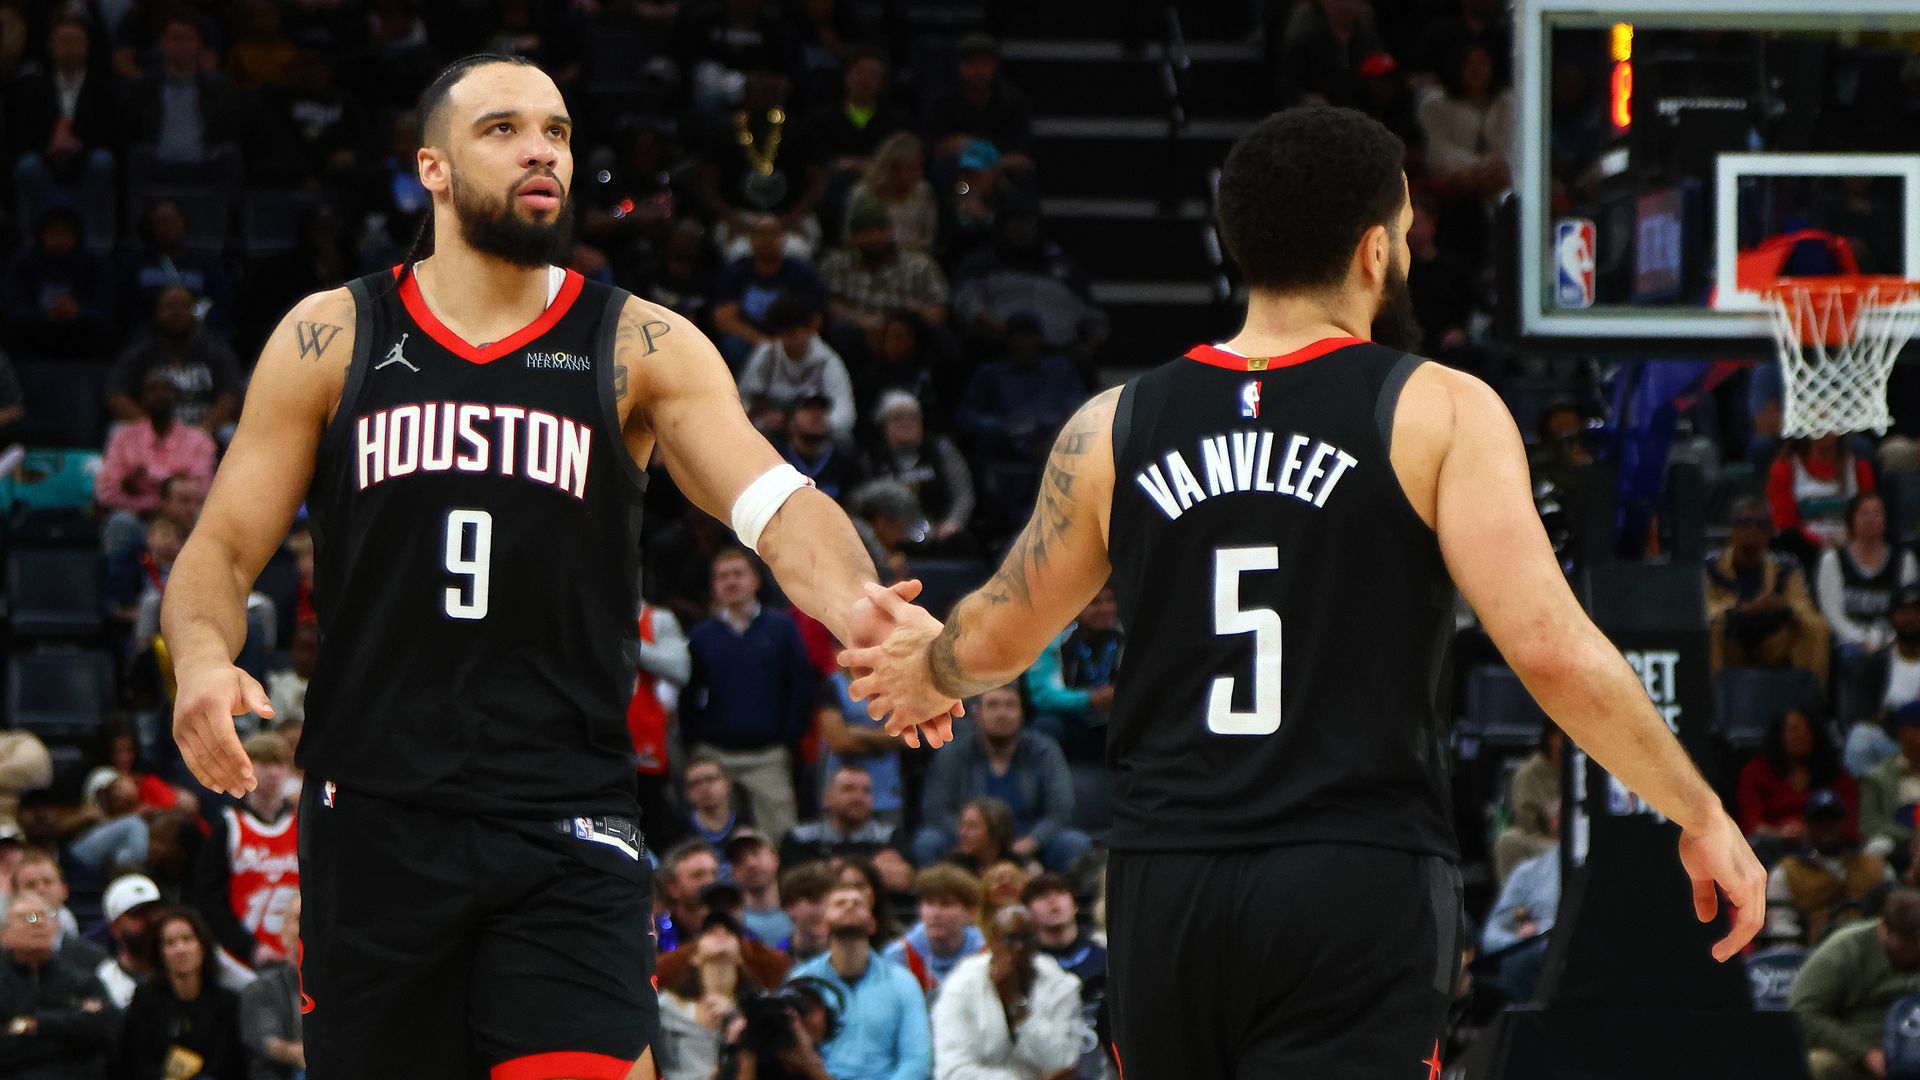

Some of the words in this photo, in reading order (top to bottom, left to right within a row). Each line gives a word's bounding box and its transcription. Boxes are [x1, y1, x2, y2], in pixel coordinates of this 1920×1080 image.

[296, 320, 343, 362] W
[526, 359, 590, 371] HERMANN
[527, 352, 590, 364] MEMORIAL
[634, 320, 671, 357] P
[357, 402, 592, 501] HOUSTON
[1136, 431, 1359, 521] VANVLEET
[445, 509, 493, 620] 9
[1207, 546, 1282, 735] 5
